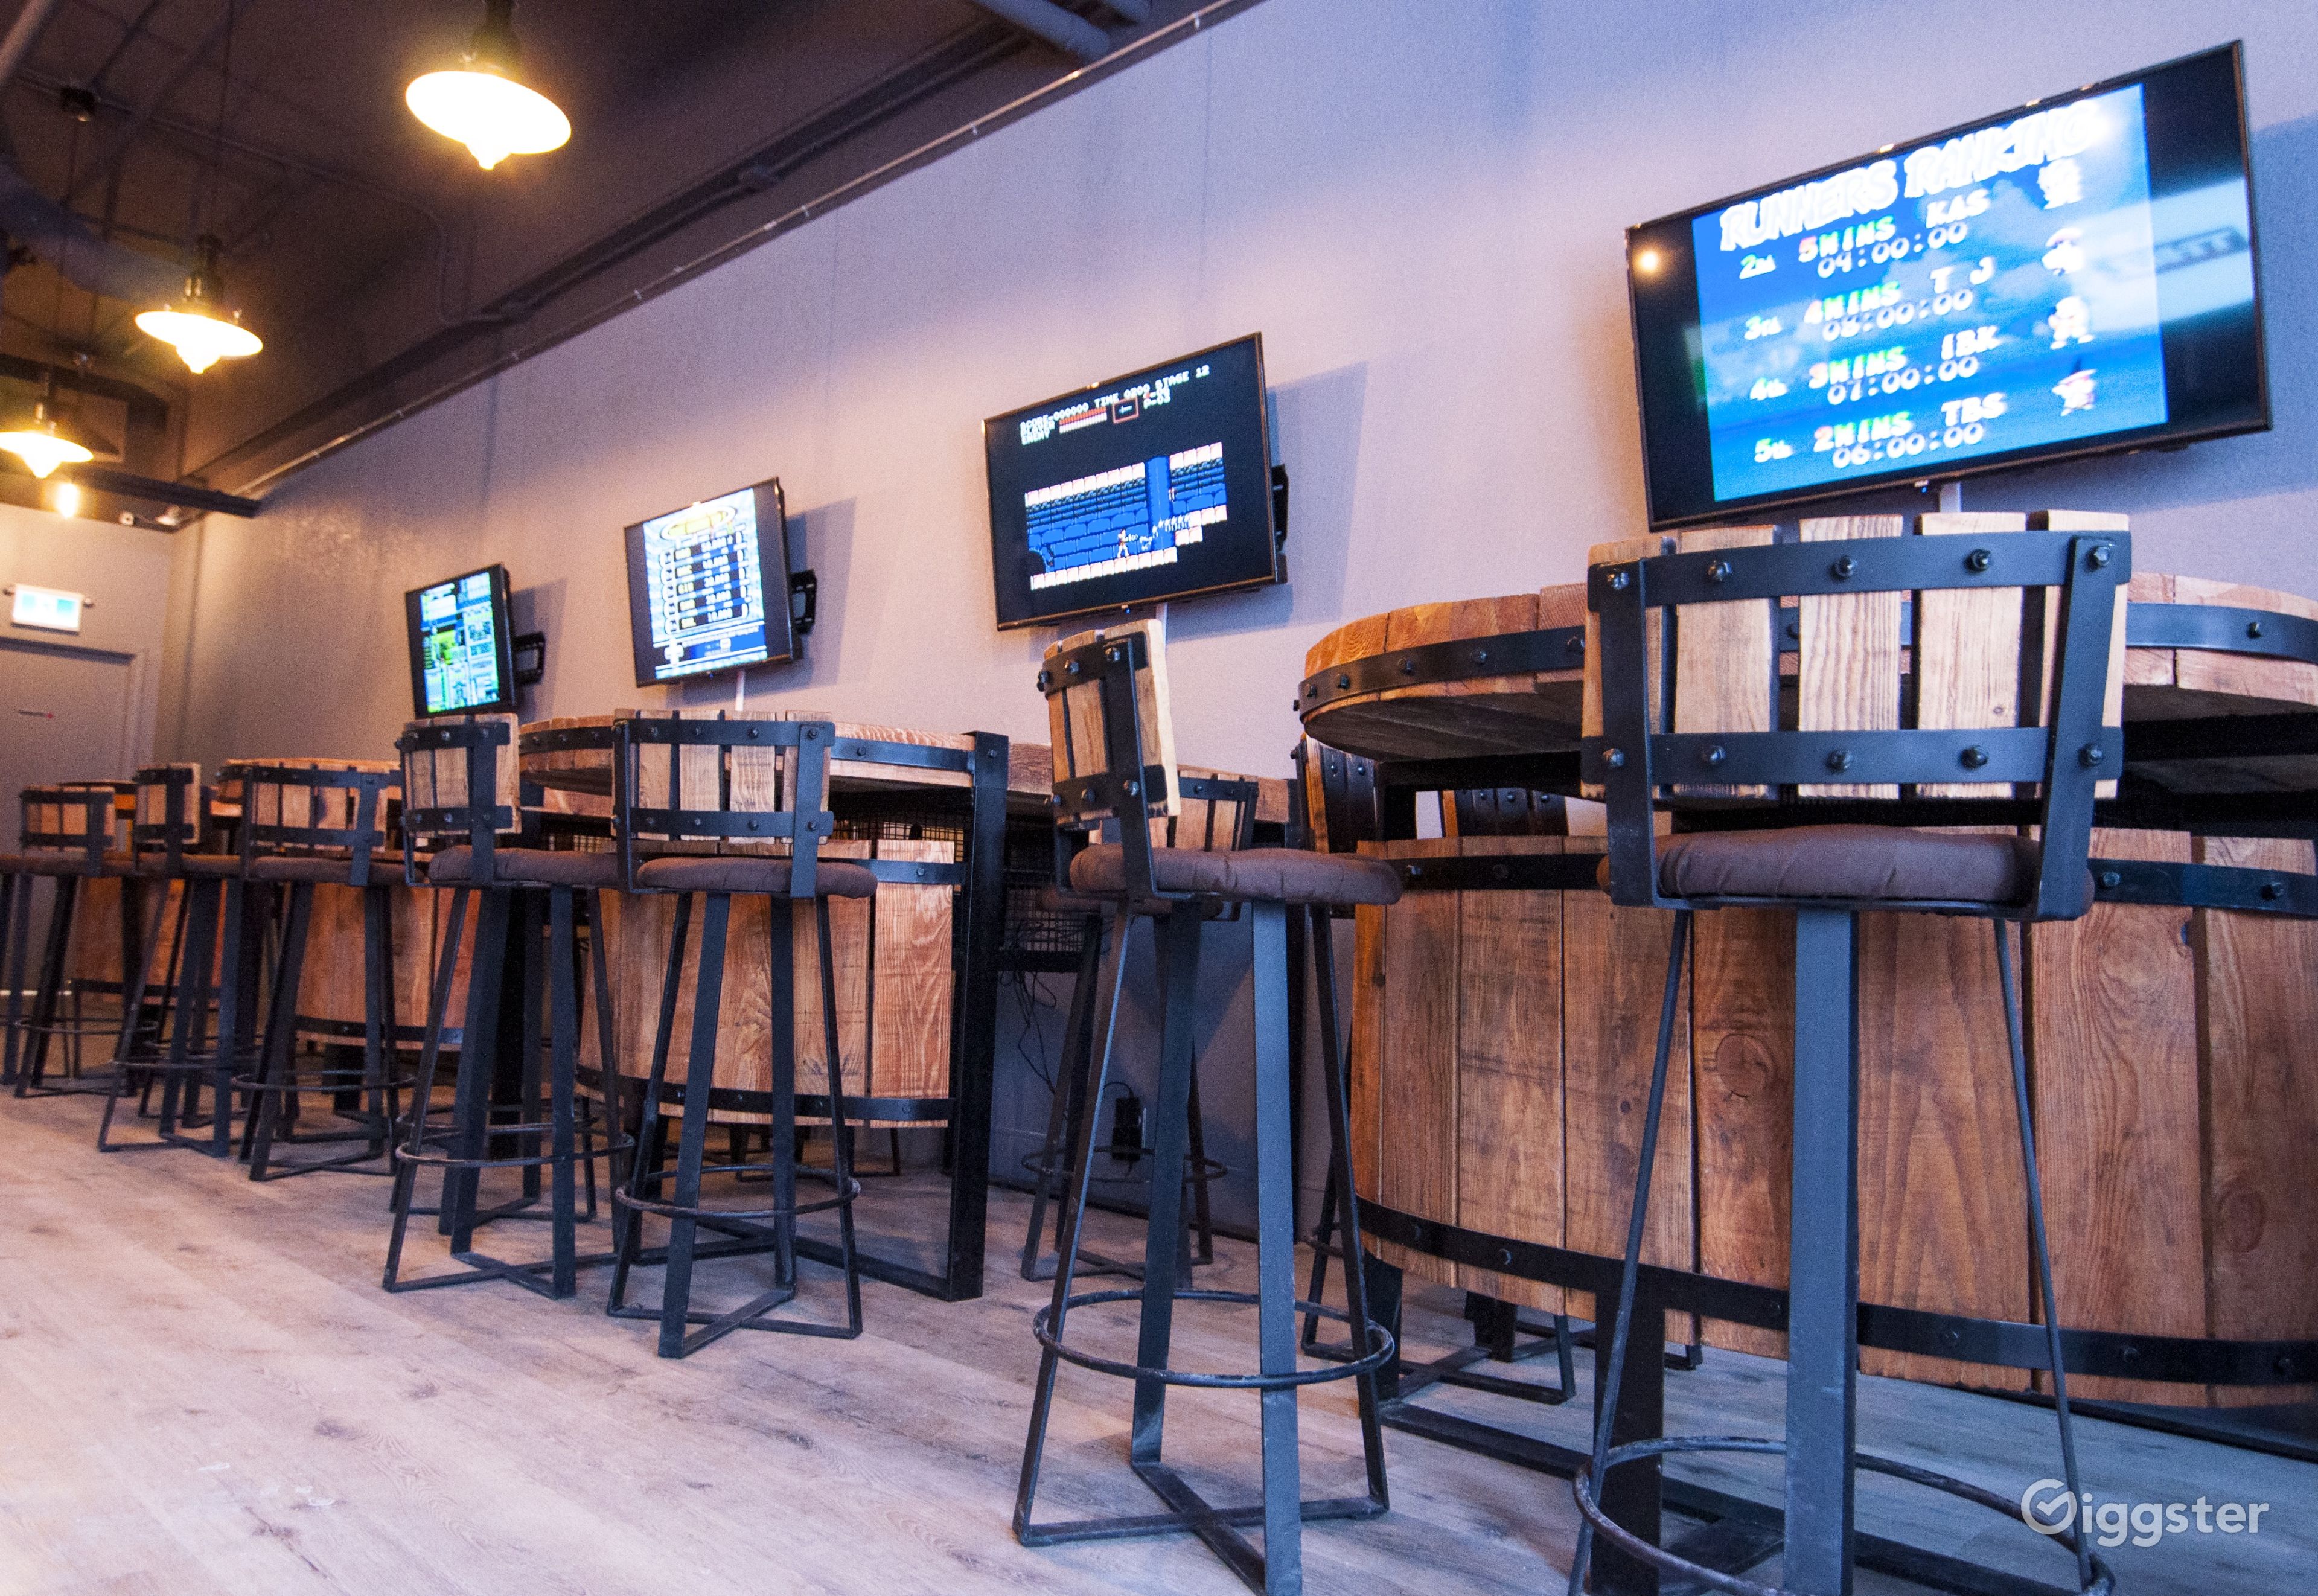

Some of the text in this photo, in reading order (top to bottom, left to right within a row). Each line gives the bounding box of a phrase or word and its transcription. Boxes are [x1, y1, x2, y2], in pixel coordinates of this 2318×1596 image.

[1720, 100, 2104, 251] RUNNERS RANKING
[1926, 188, 1991, 228] KAS
[1094, 392, 1119, 408] TIME
[1832, 423, 1984, 468] 06:00:00
